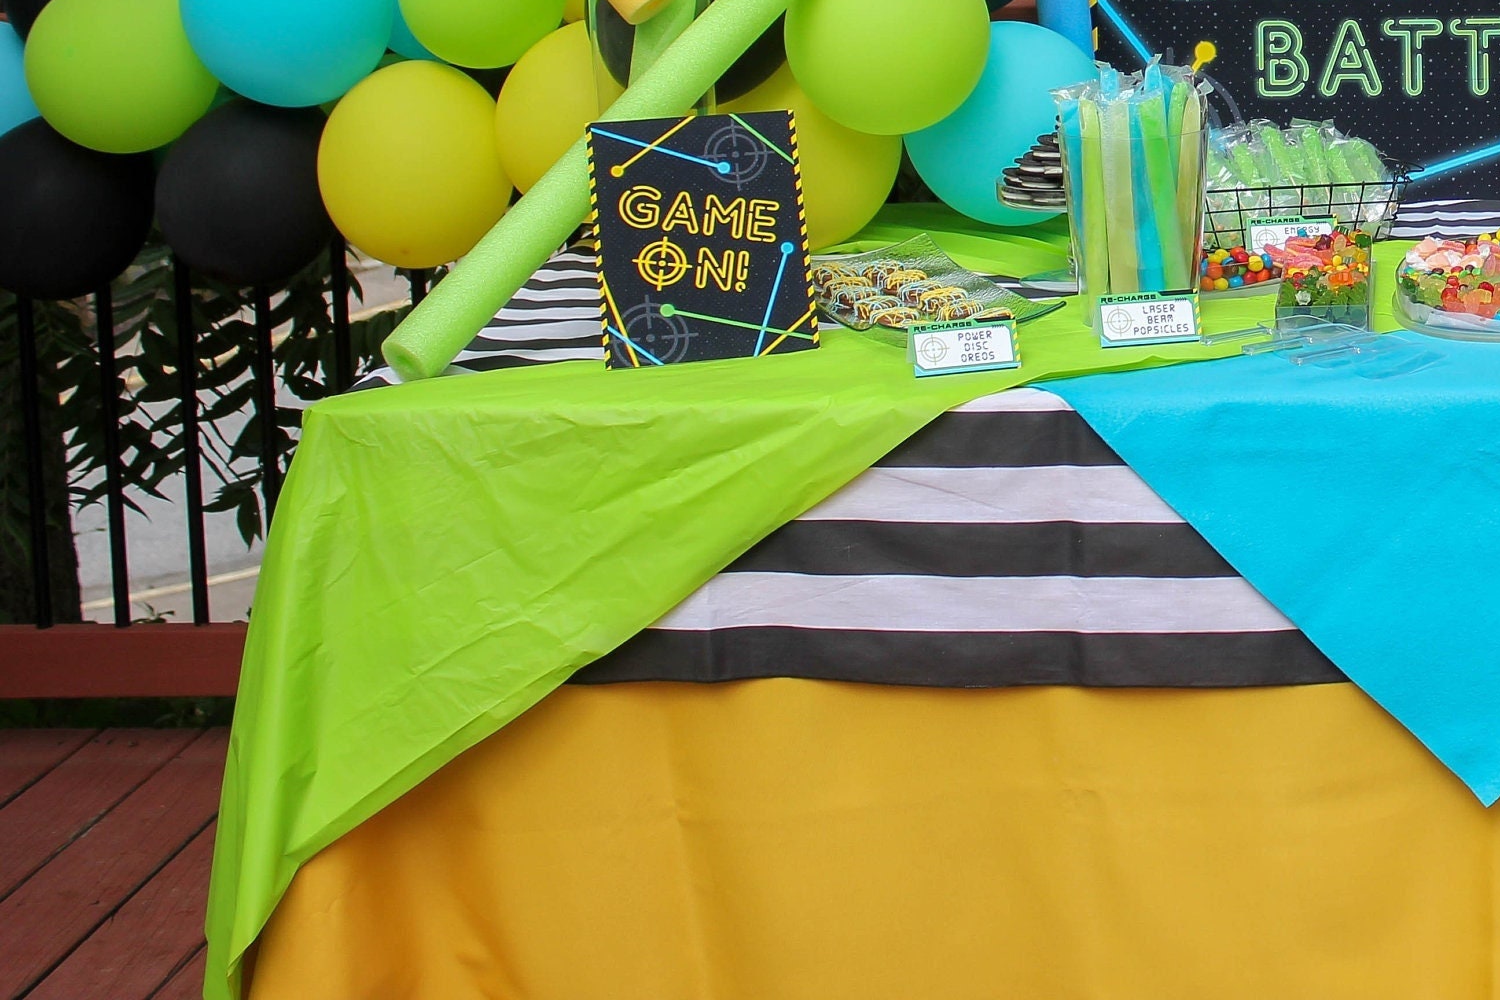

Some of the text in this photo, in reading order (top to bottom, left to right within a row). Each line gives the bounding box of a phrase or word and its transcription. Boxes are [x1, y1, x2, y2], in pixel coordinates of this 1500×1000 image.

[618, 184, 781, 244] GAME
[1250, 217, 1300, 225] RE-CHARGE
[632, 236, 750, 293] ON!
[1100, 293, 1157, 304] RE-CHARGE
[1142, 303, 1176, 315] LASER
[1147, 314, 1174, 325] BEAM
[913, 321, 973, 333] RE-CHARGE
[1133, 323, 1189, 335] POPSICLES
[957, 329, 993, 342] POWER
[964, 340, 989, 352] DISC
[960, 350, 995, 363] OREOS
